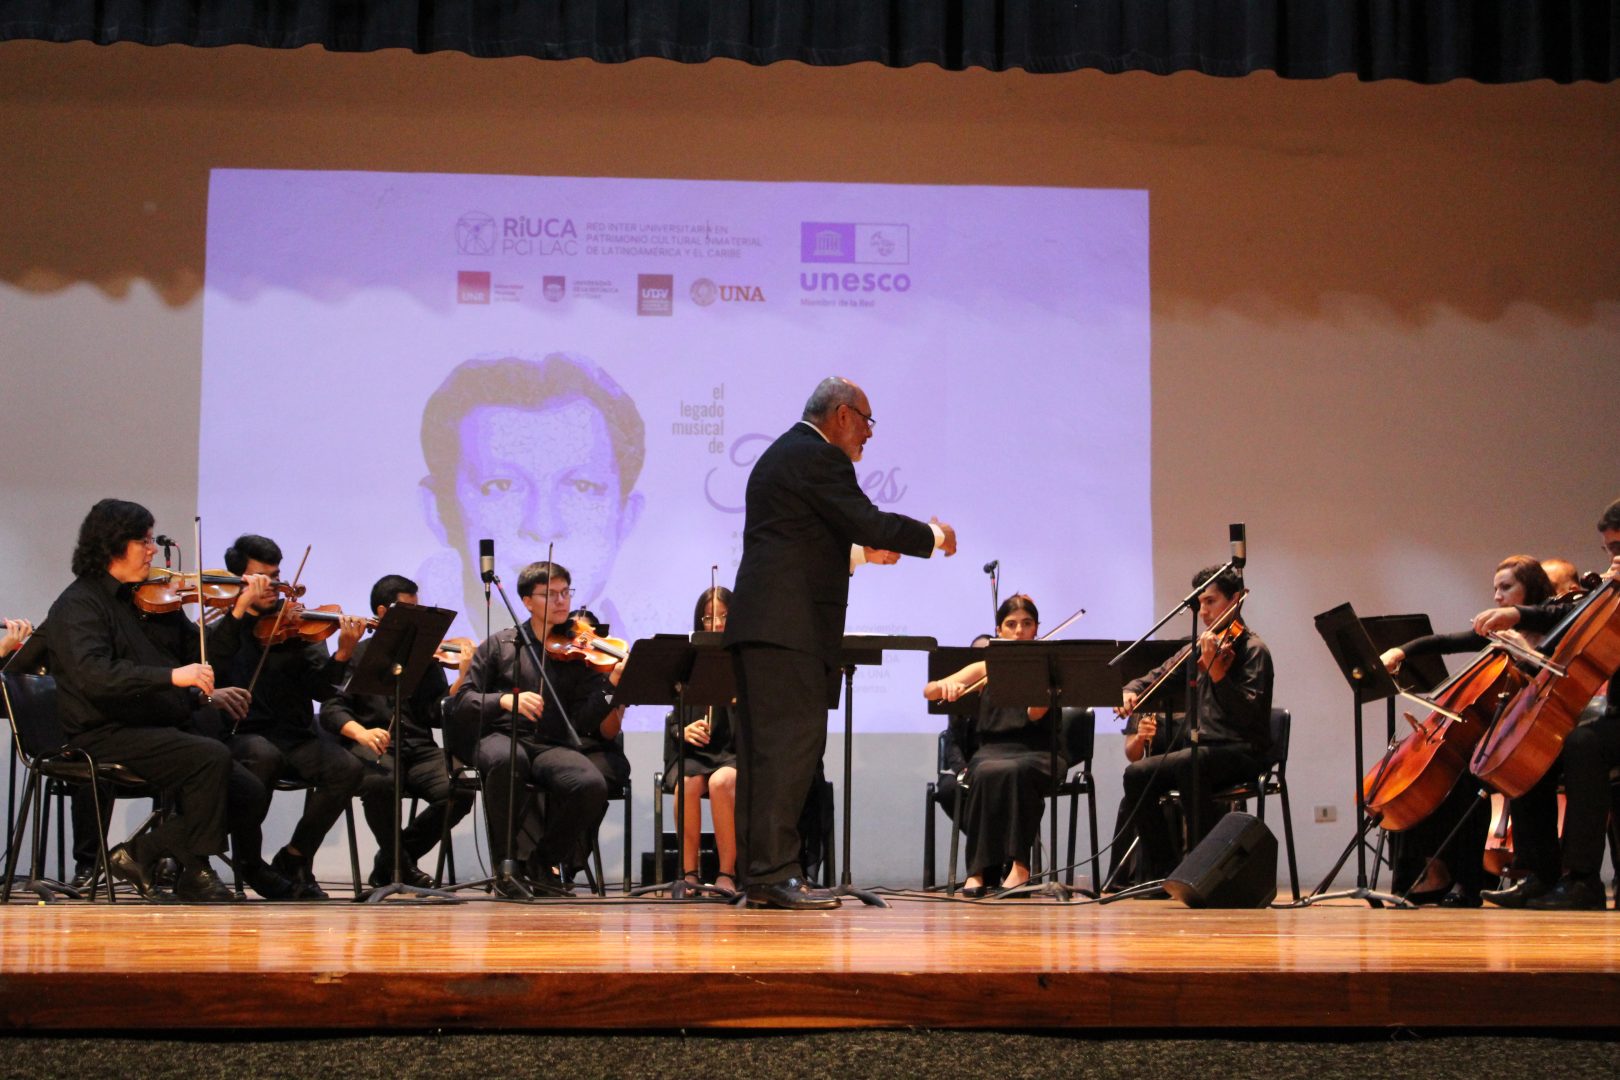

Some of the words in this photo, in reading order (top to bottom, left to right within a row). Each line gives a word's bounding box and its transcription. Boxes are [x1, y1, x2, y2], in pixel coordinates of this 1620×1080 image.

[504, 215, 577, 238] RiUCA
[586, 222, 606, 231] RED
[608, 222, 637, 232] INTER
[502, 239, 533, 255] PCI
[540, 239, 579, 256] LAC
[586, 234, 648, 244] PATRIMONIO
[650, 235, 702, 245] CULTURAL
[586, 246, 599, 255] DE
[706, 248, 742, 258] CARIBE
[800, 272, 911, 292] unesco
[719, 285, 766, 302] UNA
[712, 382, 724, 400] el
[680, 400, 725, 421] legado
[672, 420, 724, 436] musical
[708, 437, 725, 454] de
